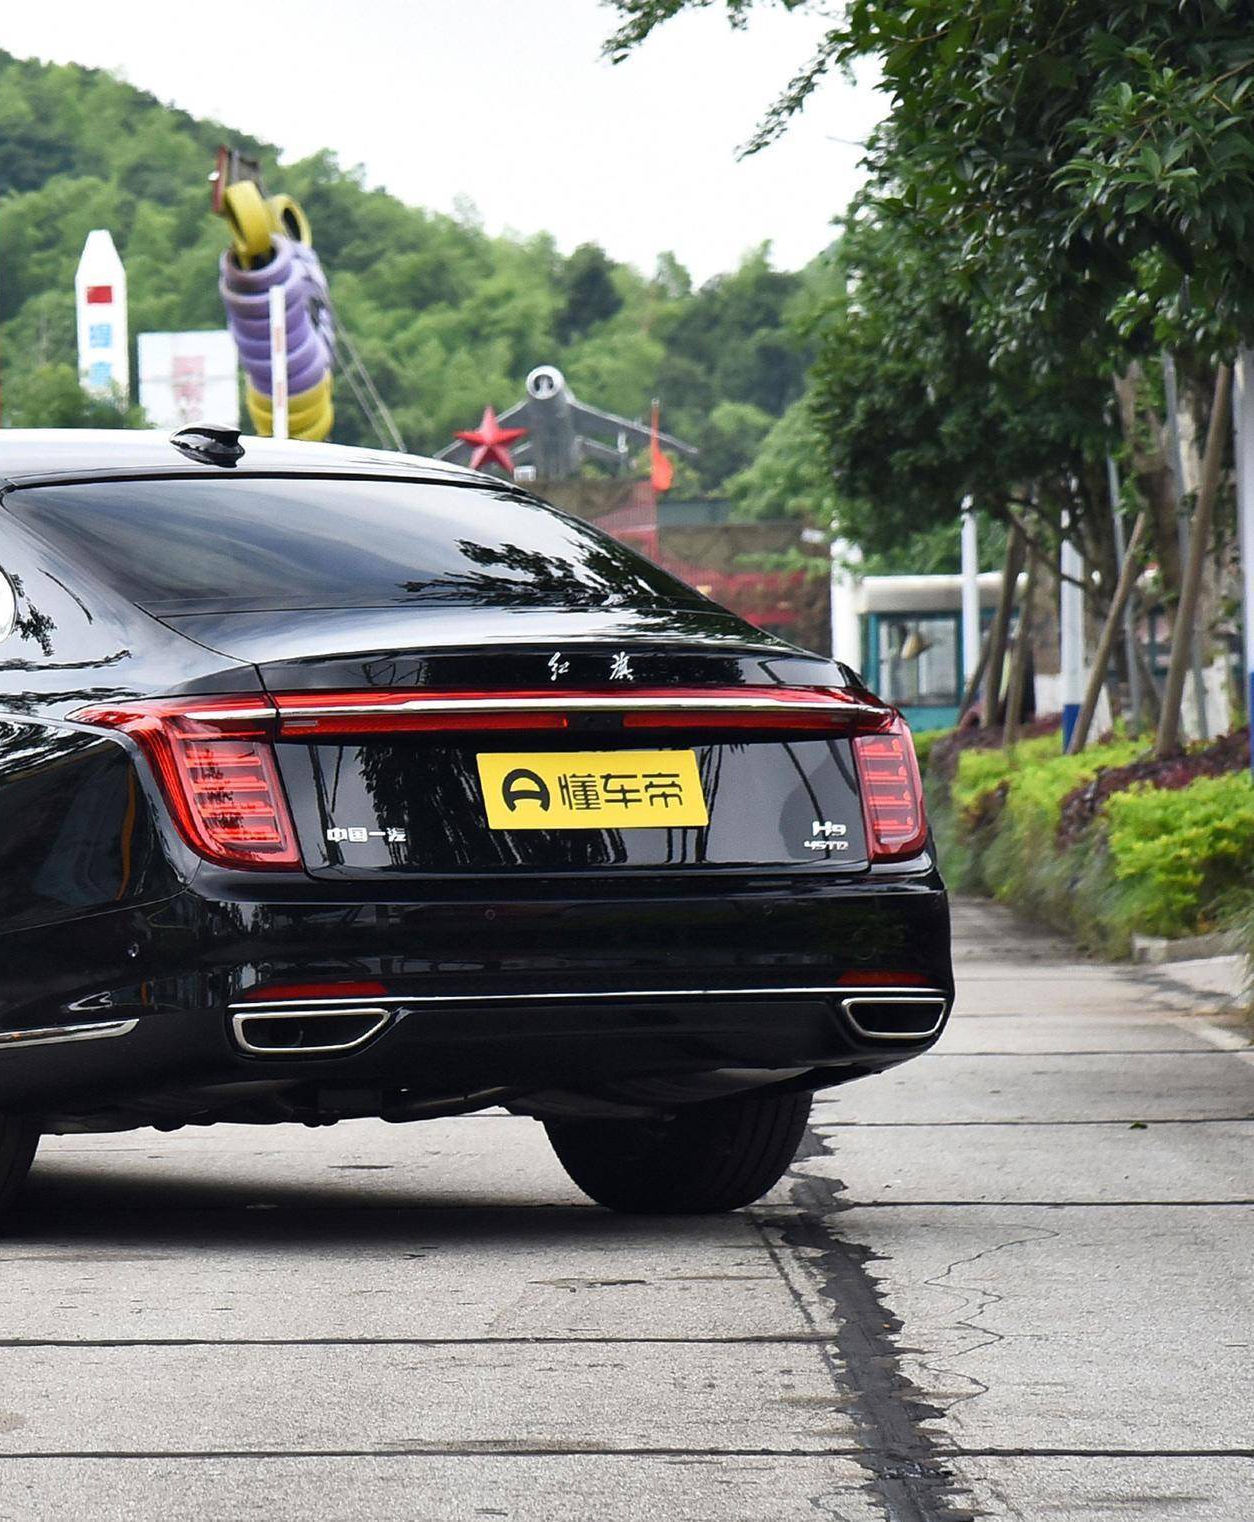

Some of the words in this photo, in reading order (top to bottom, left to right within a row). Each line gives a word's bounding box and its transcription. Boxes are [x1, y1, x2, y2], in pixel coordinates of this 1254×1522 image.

[547, 651, 634, 681] 红旗
[558, 772, 683, 810] 懂车帝
[326, 827, 407, 843] 中国一汽
[812, 820, 847, 837] H9
